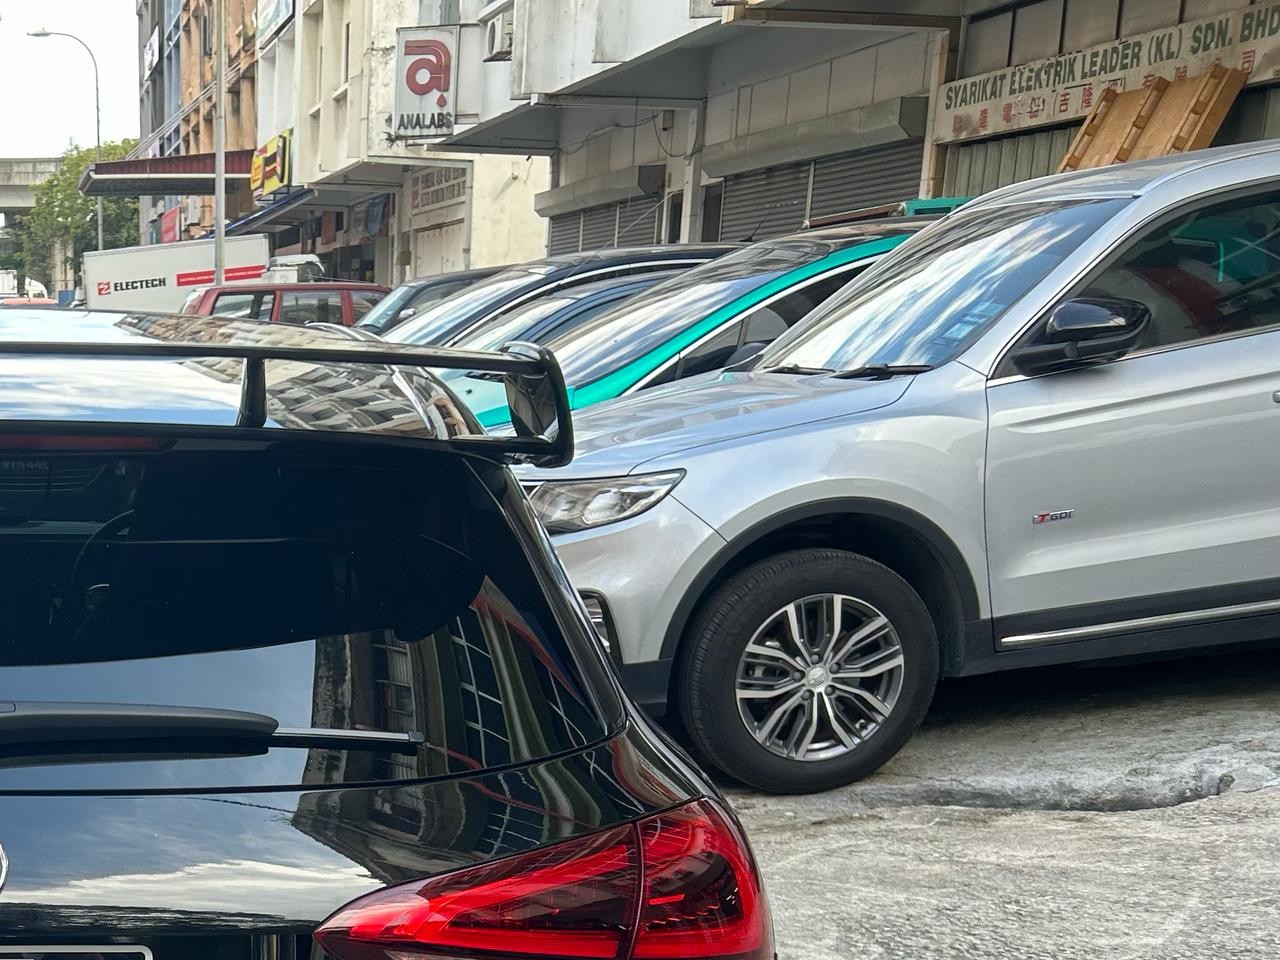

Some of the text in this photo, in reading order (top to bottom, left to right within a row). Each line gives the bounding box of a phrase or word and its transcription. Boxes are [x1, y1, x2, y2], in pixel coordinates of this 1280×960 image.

[945, 73, 1007, 110] SYARIKAT
[1009, 55, 1078, 96] ELEKTRIK
[1080, 40, 1143, 81] LEADER
[1147, 28, 1183, 66] (KL)
[1189, 17, 1233, 55] SDN.
[397, 111, 453, 130] ANALABS
[113, 277, 166, 292] ELECTECH
